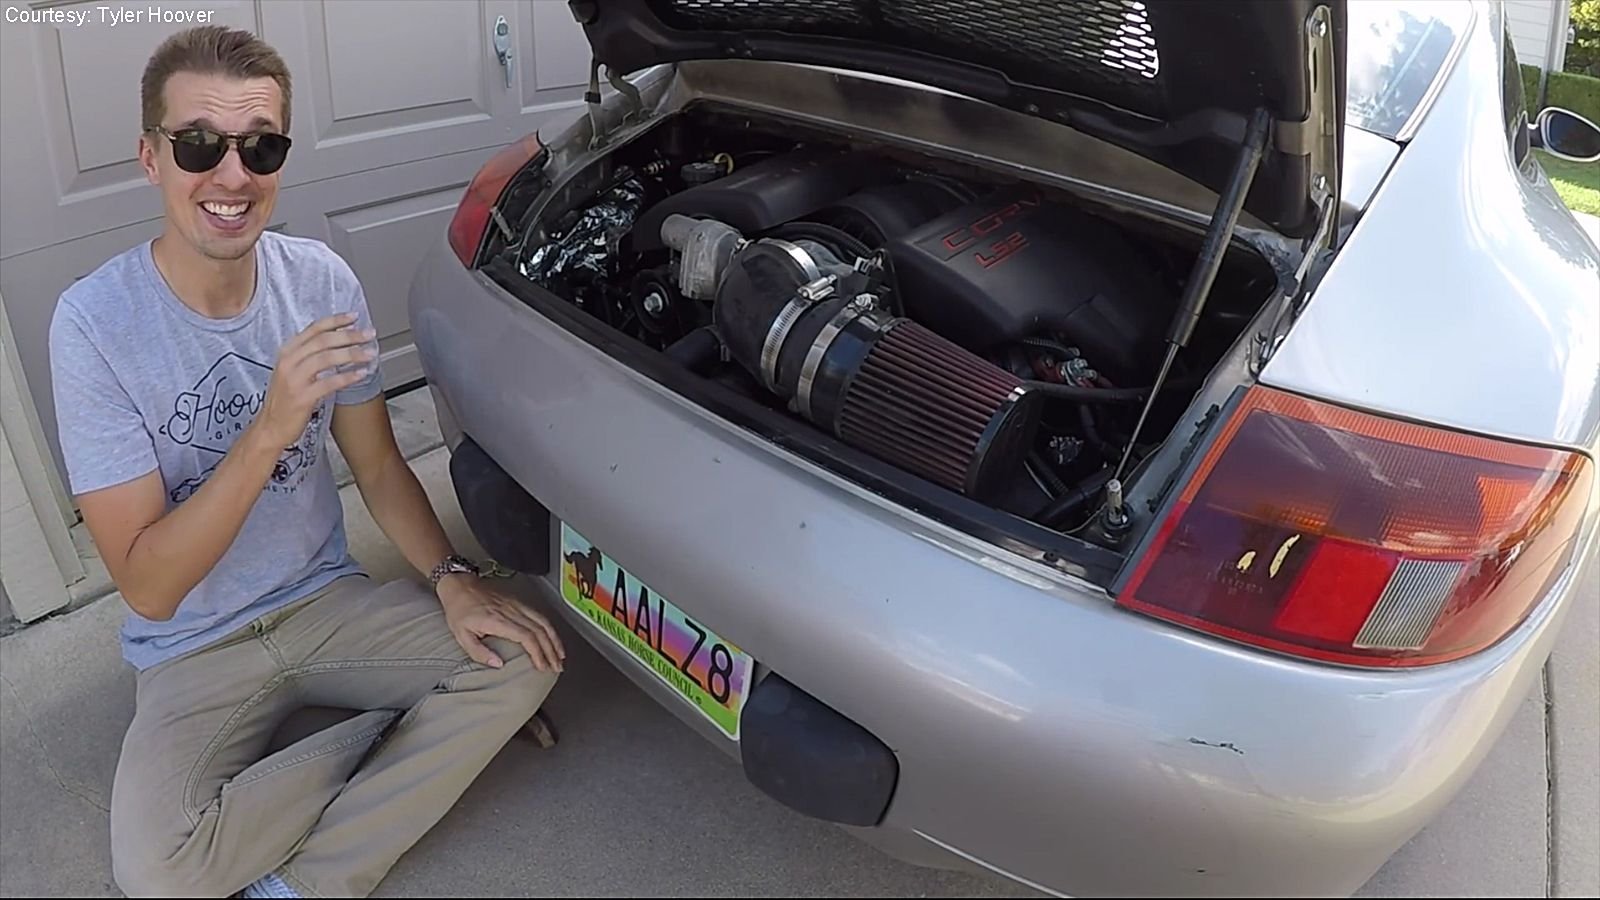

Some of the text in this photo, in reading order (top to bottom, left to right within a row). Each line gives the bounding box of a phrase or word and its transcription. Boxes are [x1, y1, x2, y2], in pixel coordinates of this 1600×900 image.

[594, 609, 694, 700] KANSAS HORSE COUNCIL
[611, 567, 733, 704] AALZ8
